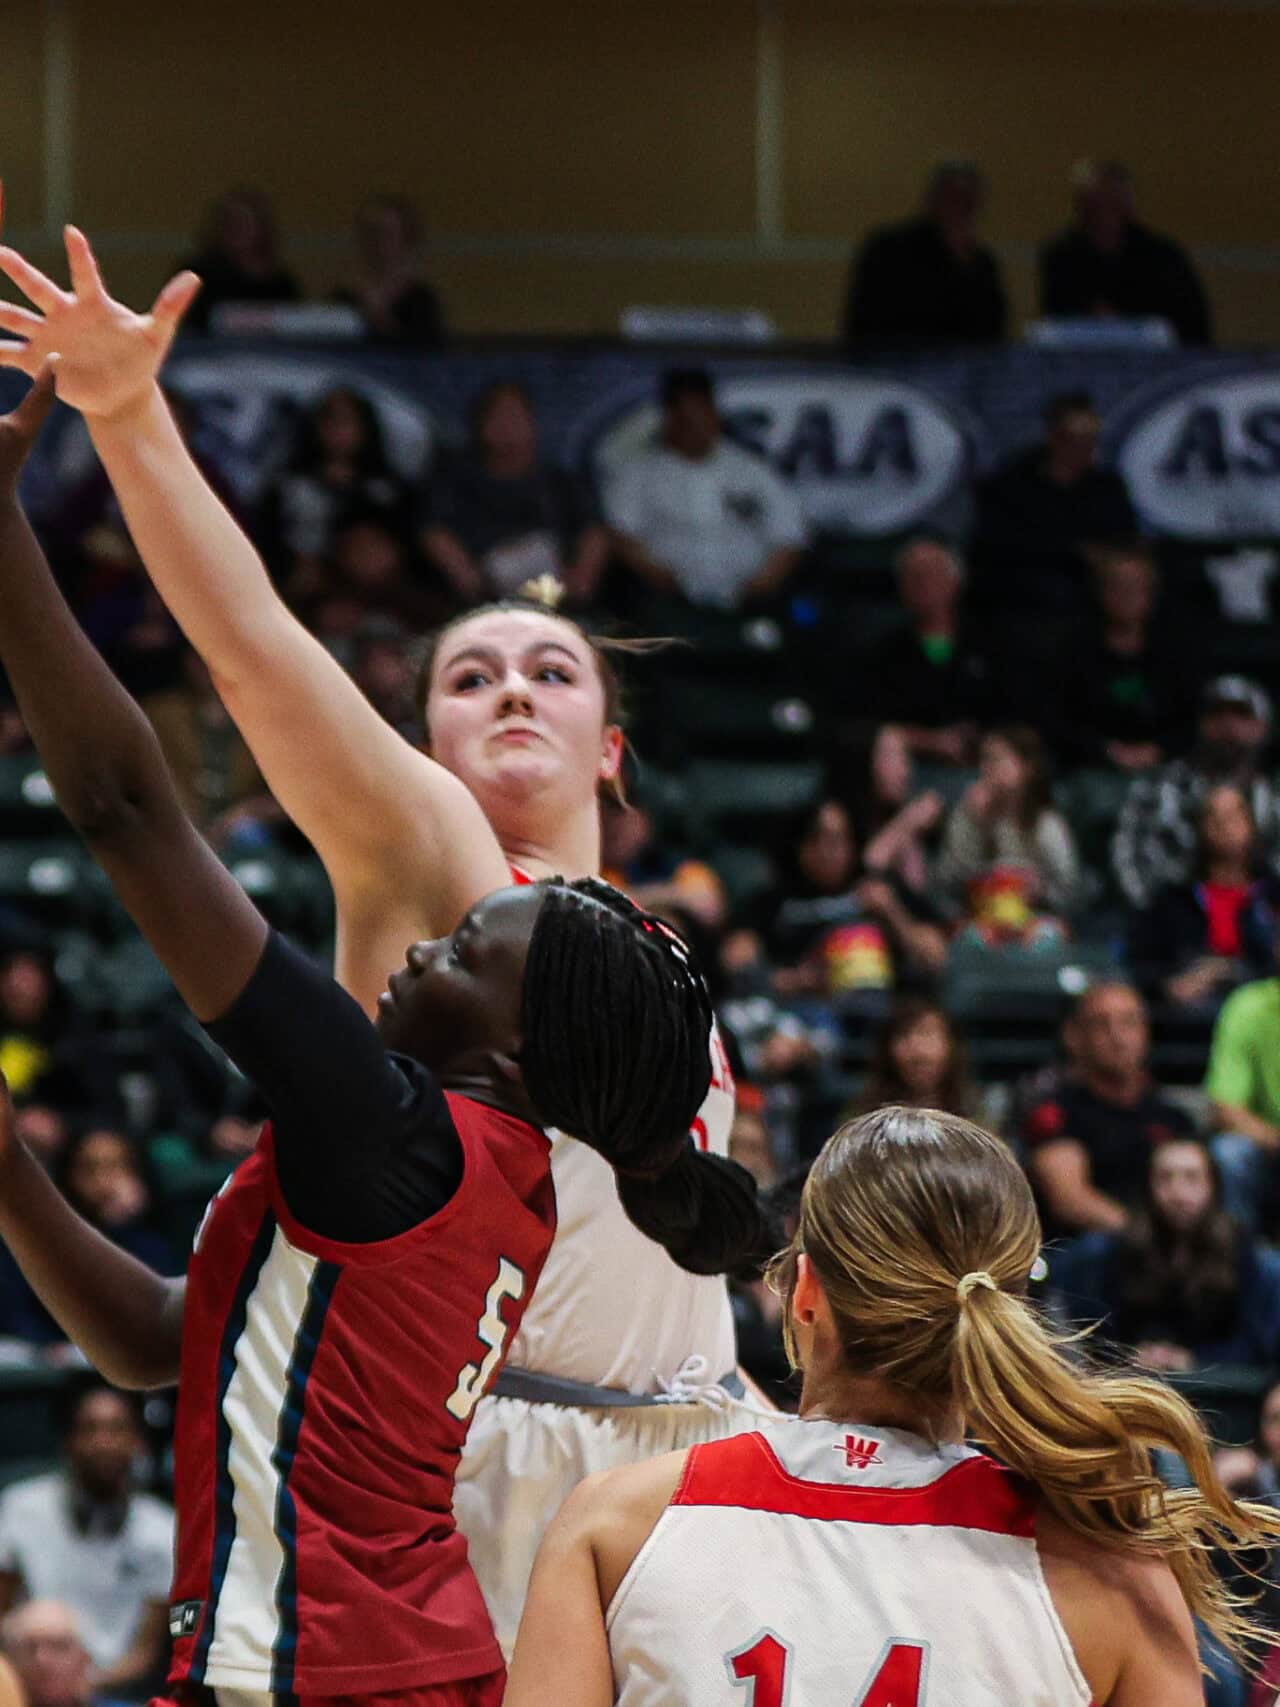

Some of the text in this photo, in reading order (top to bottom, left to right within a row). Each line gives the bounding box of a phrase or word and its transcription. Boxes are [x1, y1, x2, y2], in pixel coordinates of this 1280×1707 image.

[718, 402, 922, 478] SAA
[1160, 404, 1280, 478] AS
[445, 1255, 526, 1422] 5
